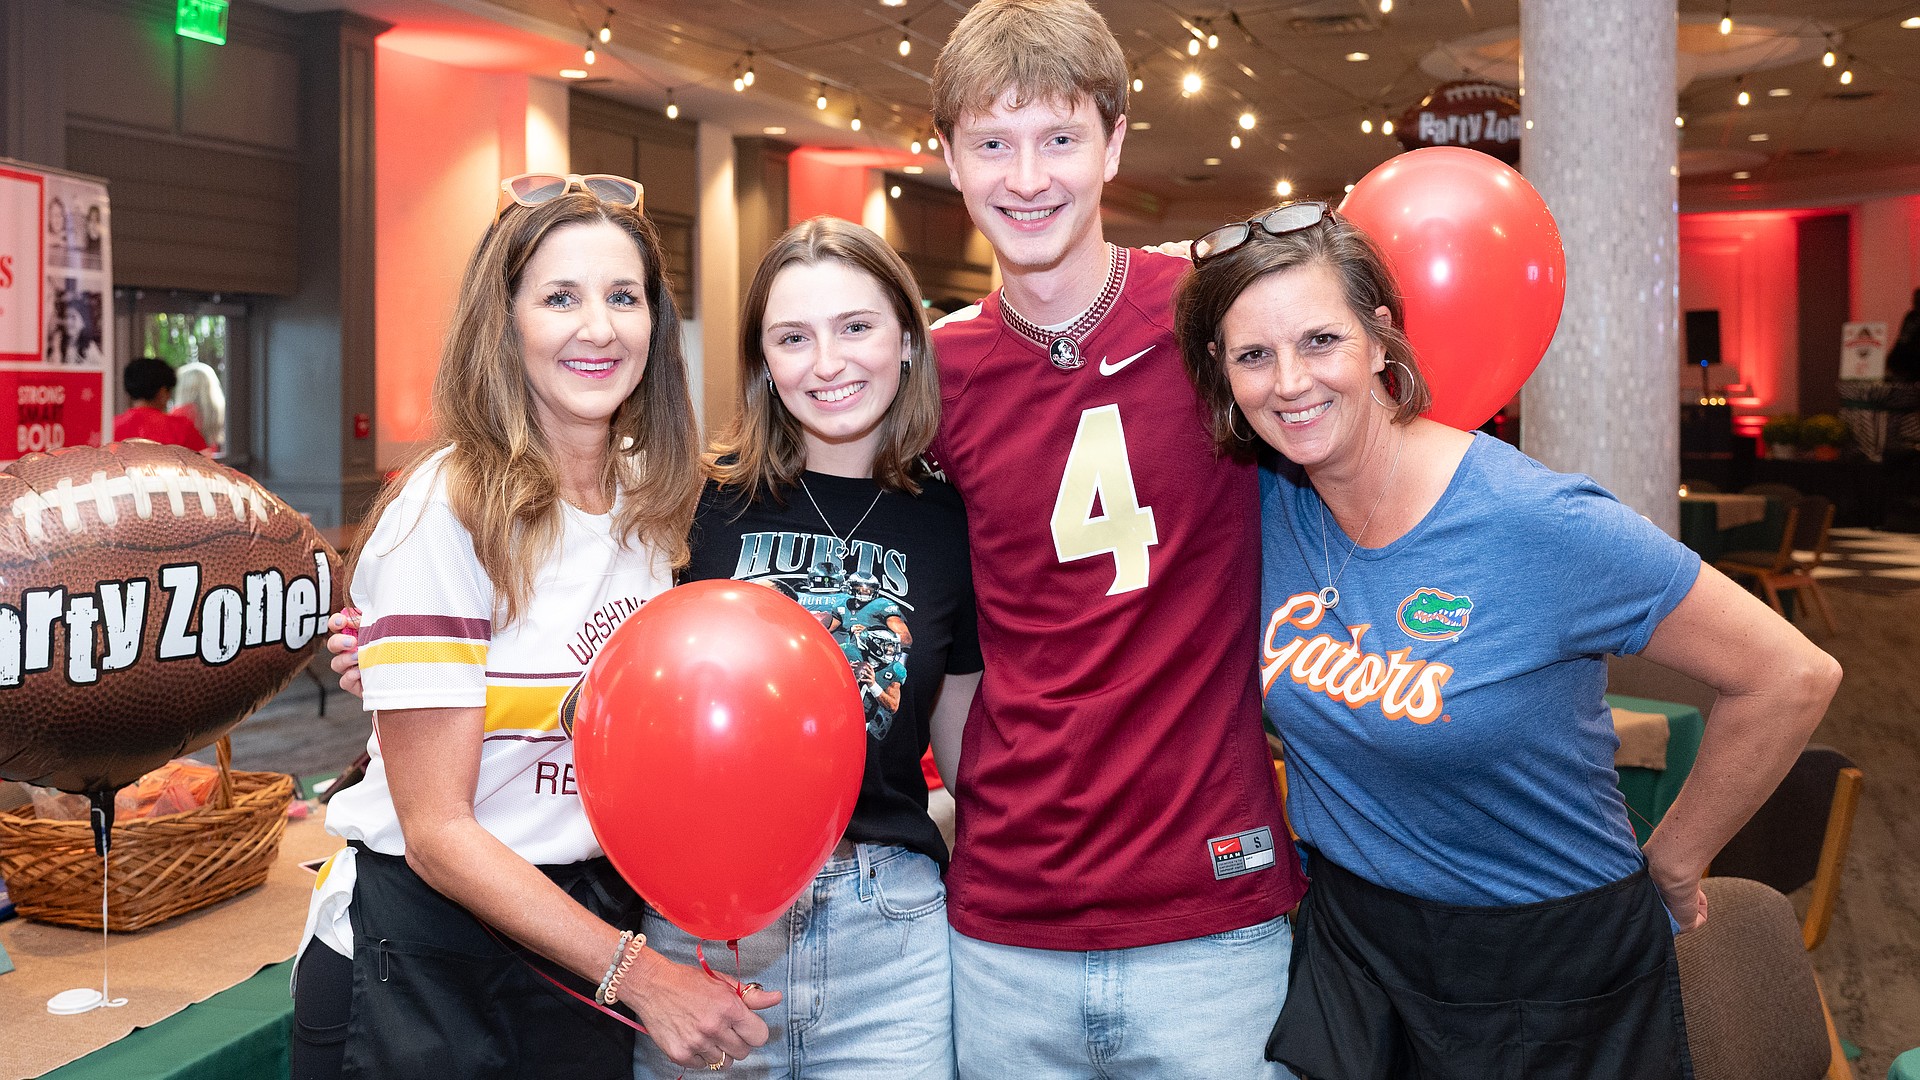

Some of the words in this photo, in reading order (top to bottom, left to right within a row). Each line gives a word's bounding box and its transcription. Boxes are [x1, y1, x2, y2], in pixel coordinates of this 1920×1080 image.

[1418, 111, 1482, 145] Party
[18, 385, 65, 405] STRONG
[17, 423, 65, 452] BOLD
[1050, 403, 1158, 596] 4
[730, 531, 909, 597] HURTS
[160, 551, 331, 664] Zone!
[799, 596, 837, 606] HURTS
[567, 597, 647, 665] WASHIN
[1260, 591, 1454, 724] Gators
[1218, 852, 1241, 860] TEAM
[1253, 836, 1262, 848] S
